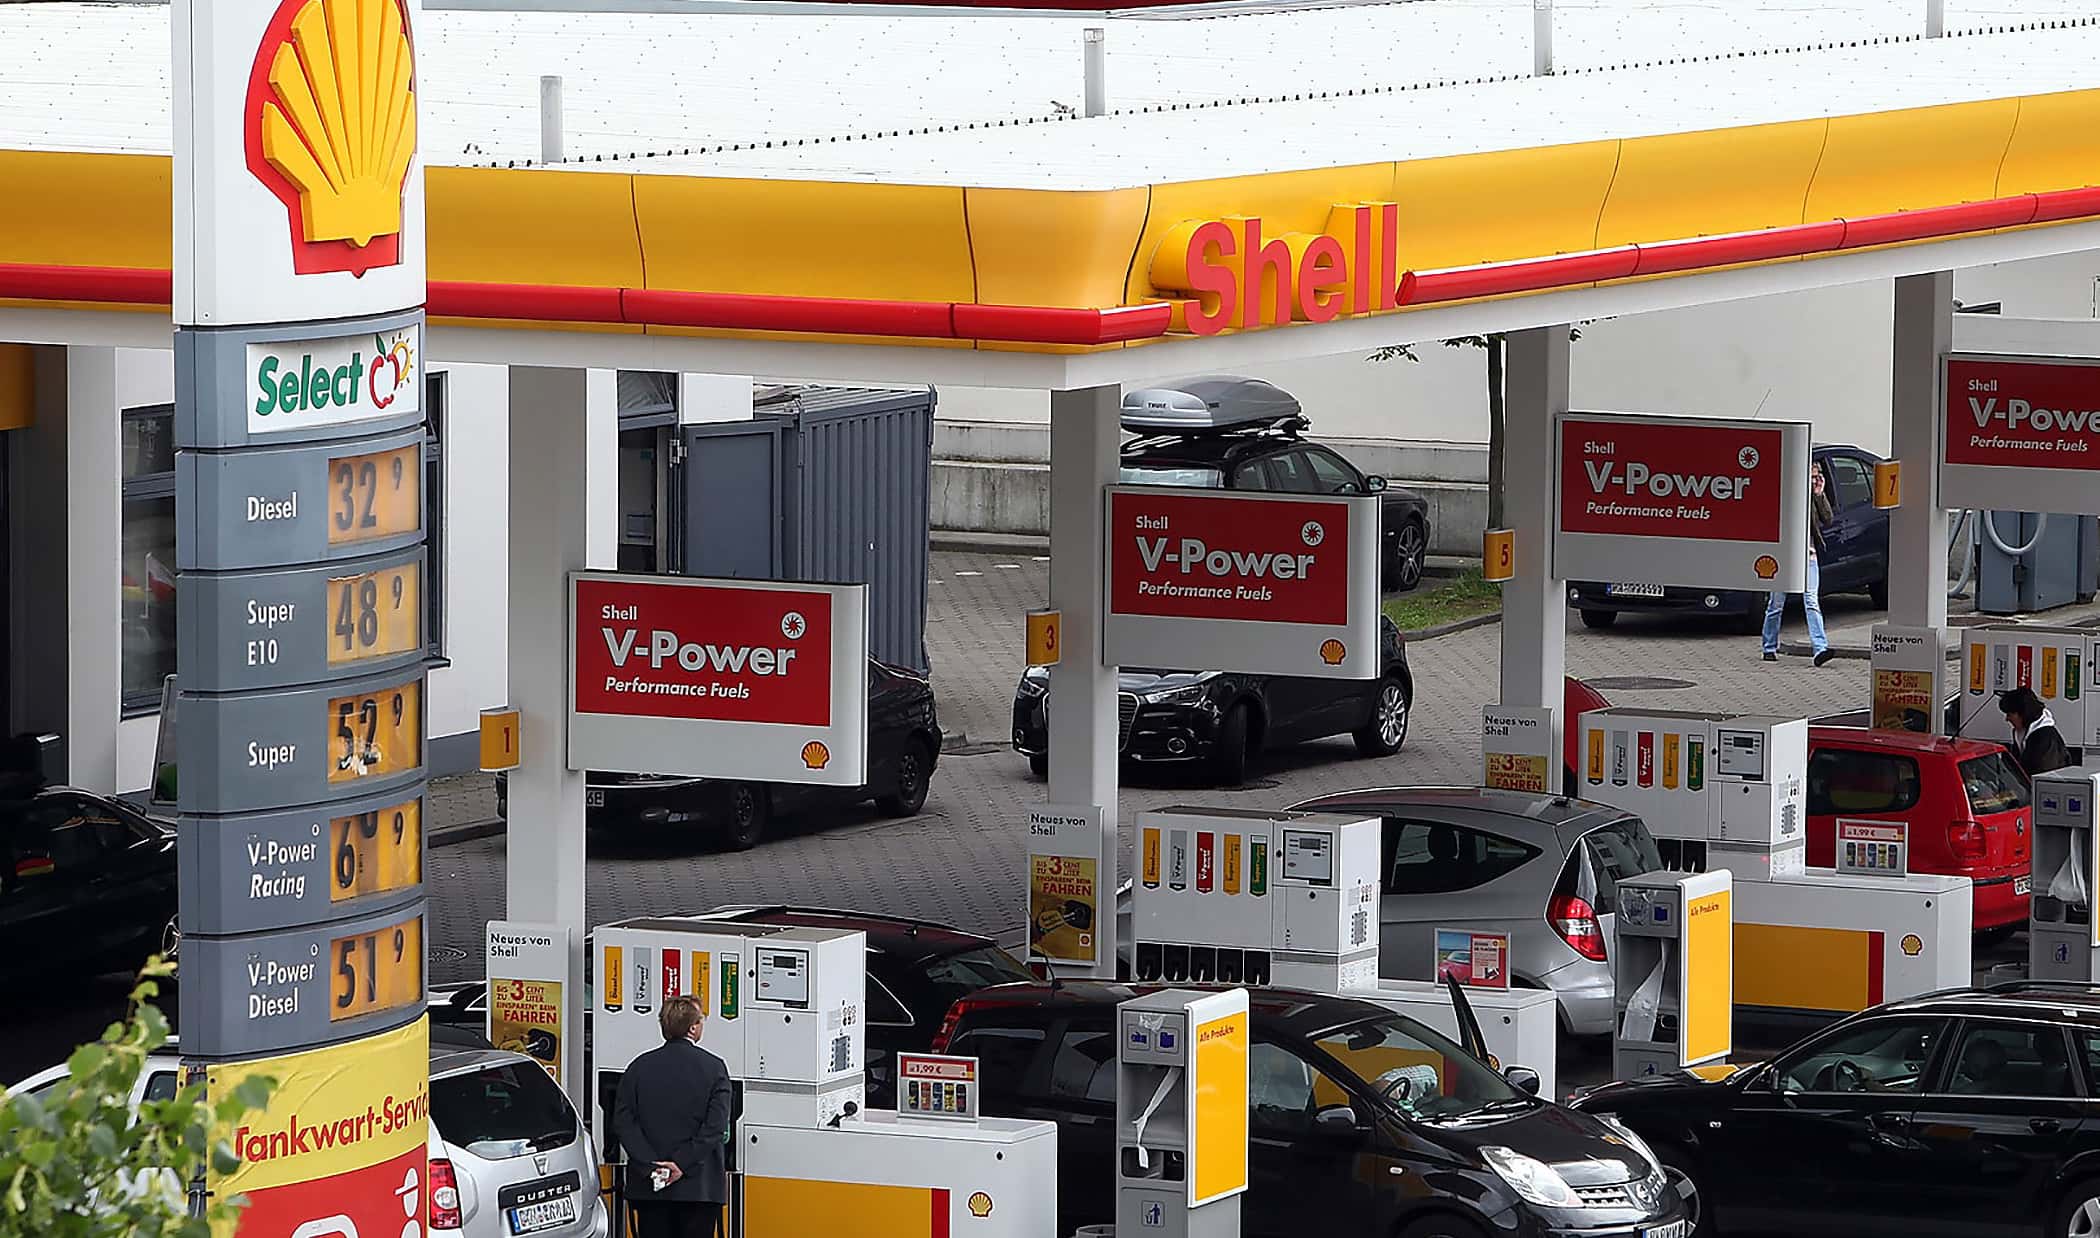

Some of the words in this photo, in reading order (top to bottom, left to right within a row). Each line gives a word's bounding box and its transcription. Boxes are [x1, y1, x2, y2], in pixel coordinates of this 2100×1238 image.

[1184, 202, 1398, 336] Shell
[255, 352, 363, 416] Select
[1968, 379, 1998, 391] Shell
[1968, 397, 2100, 432] V-Powe
[1584, 441, 1615, 455] Shell
[1970, 435, 2054, 450] Performance
[2056, 439, 2088, 452] Fuels
[1584, 461, 1750, 500] V-Power
[1889, 474, 1897, 496] 7
[247, 492, 297, 521] Diesel
[335, 461, 377, 531] 32
[1586, 502, 1673, 518] Performance
[1676, 506, 1711, 520] Fuels
[1136, 516, 1168, 530] Shell
[1136, 536, 1315, 579] V-Power
[1501, 544, 1510, 567] 5
[1138, 581, 1233, 599] Performance
[1235, 586, 1273, 601] Fuels
[247, 600, 295, 629] Super
[335, 579, 377, 652] 48
[602, 605, 637, 620] Shell
[1046, 624, 1055, 651] 3
[1874, 634, 1903, 643] Neues
[1874, 644, 1896, 653] Shell
[248, 639, 278, 666] E10
[601, 627, 796, 676] V-Power
[605, 677, 707, 696] Performance
[710, 682, 750, 699] Fuels
[1891, 672, 1902, 687] 3
[1485, 715, 1516, 726] Neues
[1519, 719, 1537, 727] von
[1485, 726, 1509, 736] Shell
[337, 699, 378, 770] 52
[503, 727, 510, 753] 1
[249, 742, 296, 771] Super
[1502, 754, 1514, 772] 3
[1496, 779, 1542, 791] FAHREN
[1030, 813, 1064, 825] Neues
[1066, 817, 1086, 826] von
[1030, 825, 1055, 836] Shell
[247, 840, 317, 866] V-Power
[1049, 856, 1062, 875] 3
[250, 873, 305, 899] Racing
[1043, 883, 1091, 896] FAHREN
[490, 933, 527, 945] Neues
[530, 936, 551, 946] von
[490, 946, 518, 957] Shell
[248, 962, 315, 987] V-Power
[337, 936, 376, 1008] 51
[511, 980, 524, 1000] 3
[249, 988, 299, 1020] Diesel
[503, 1010, 557, 1024] FAHREN
[234, 1081, 428, 1162] Tankwart-Servic
[517, 1184, 571, 1203] DUSTER
